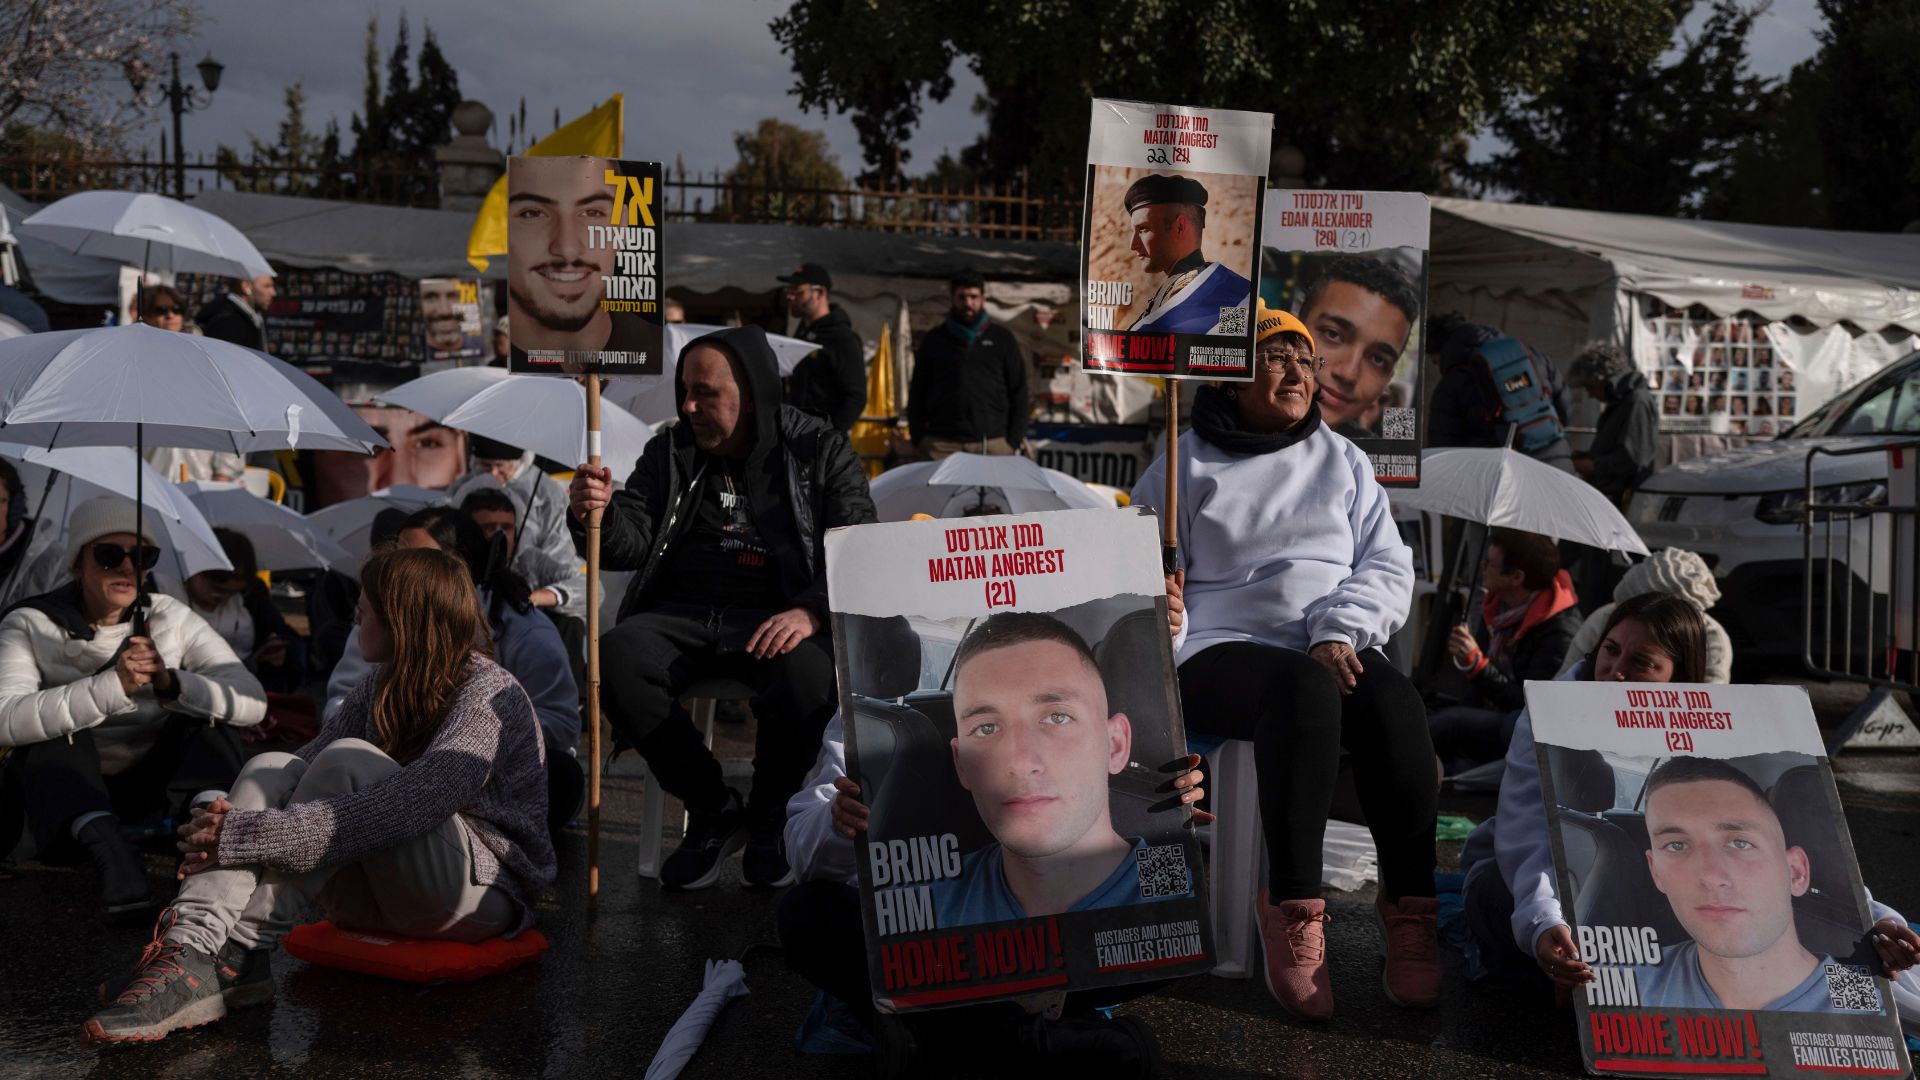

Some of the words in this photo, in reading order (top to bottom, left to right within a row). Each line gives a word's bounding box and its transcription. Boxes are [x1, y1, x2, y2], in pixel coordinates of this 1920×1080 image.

[1155, 113, 1190, 131] אנגרסט
[1192, 115, 1209, 132] מתן
[1144, 130, 1176, 146] MATAN
[1178, 131, 1219, 149] ANGREST
[1147, 148, 1172, 165] 22
[604, 169, 655, 226] אל
[1292, 192, 1338, 210] אלכסנדר
[1340, 194, 1363, 211] עידן
[1281, 211, 1309, 227] EDAN
[1311, 212, 1372, 228] ALEXANDER
[587, 225, 656, 251] תשאירו
[1341, 229, 1371, 249] (21)
[616, 251, 656, 276] אותי
[600, 275, 656, 300] מאחור
[1087, 280, 1133, 306] BRING
[642, 301, 657, 313] רום
[1088, 305, 1114, 330] HIM
[1257, 317, 1282, 334] NOW
[1087, 332, 1126, 359] HOME
[1129, 334, 1175, 361] NOW!
[1189, 346, 1214, 355] HOSTAGES
[1214, 347, 1225, 355] AND
[1225, 347, 1246, 356] MISSING
[1188, 354, 1220, 366] FAMILIES
[1220, 355, 1246, 367] FORUM
[1379, 454, 1391, 464] AND
[1391, 455, 1417, 464] MISSING
[1387, 464, 1416, 478] FORUM
[945, 525, 1008, 553] אנגרסט
[1011, 522, 1044, 551] מתן
[928, 555, 987, 583] MATAN
[991, 549, 1065, 578] ANGREST
[985, 579, 1017, 609] (21)
[1626, 690, 1681, 709] אנגרסט
[1683, 690, 1712, 710] מתן
[1615, 710, 1665, 729] MATAN
[1669, 711, 1733, 730] ANGREST
[1665, 731, 1694, 752] (21)
[868, 832, 962, 887] BRING
[874, 885, 935, 937] HIM
[1094, 927, 1140, 945] HOSTAGES
[1140, 924, 1160, 940] AND
[1160, 920, 1199, 938] MISSING
[881, 935, 971, 990] HOME
[974, 916, 1064, 979] NOW!
[1096, 941, 1155, 968] FAMILIES
[1156, 934, 1203, 961] FORUM
[1577, 925, 1661, 965] BRING
[1585, 967, 1639, 1007] HIM
[1589, 1012, 1672, 1055] HOME
[1676, 1011, 1762, 1059] NOW!
[1789, 1032, 1834, 1048] HOSTAGES
[1836, 1034, 1854, 1049] AND
[1854, 1035, 1894, 1050] MISSING
[1793, 1047, 1851, 1068] FAMILIES
[1854, 1050, 1900, 1071] FORUM
